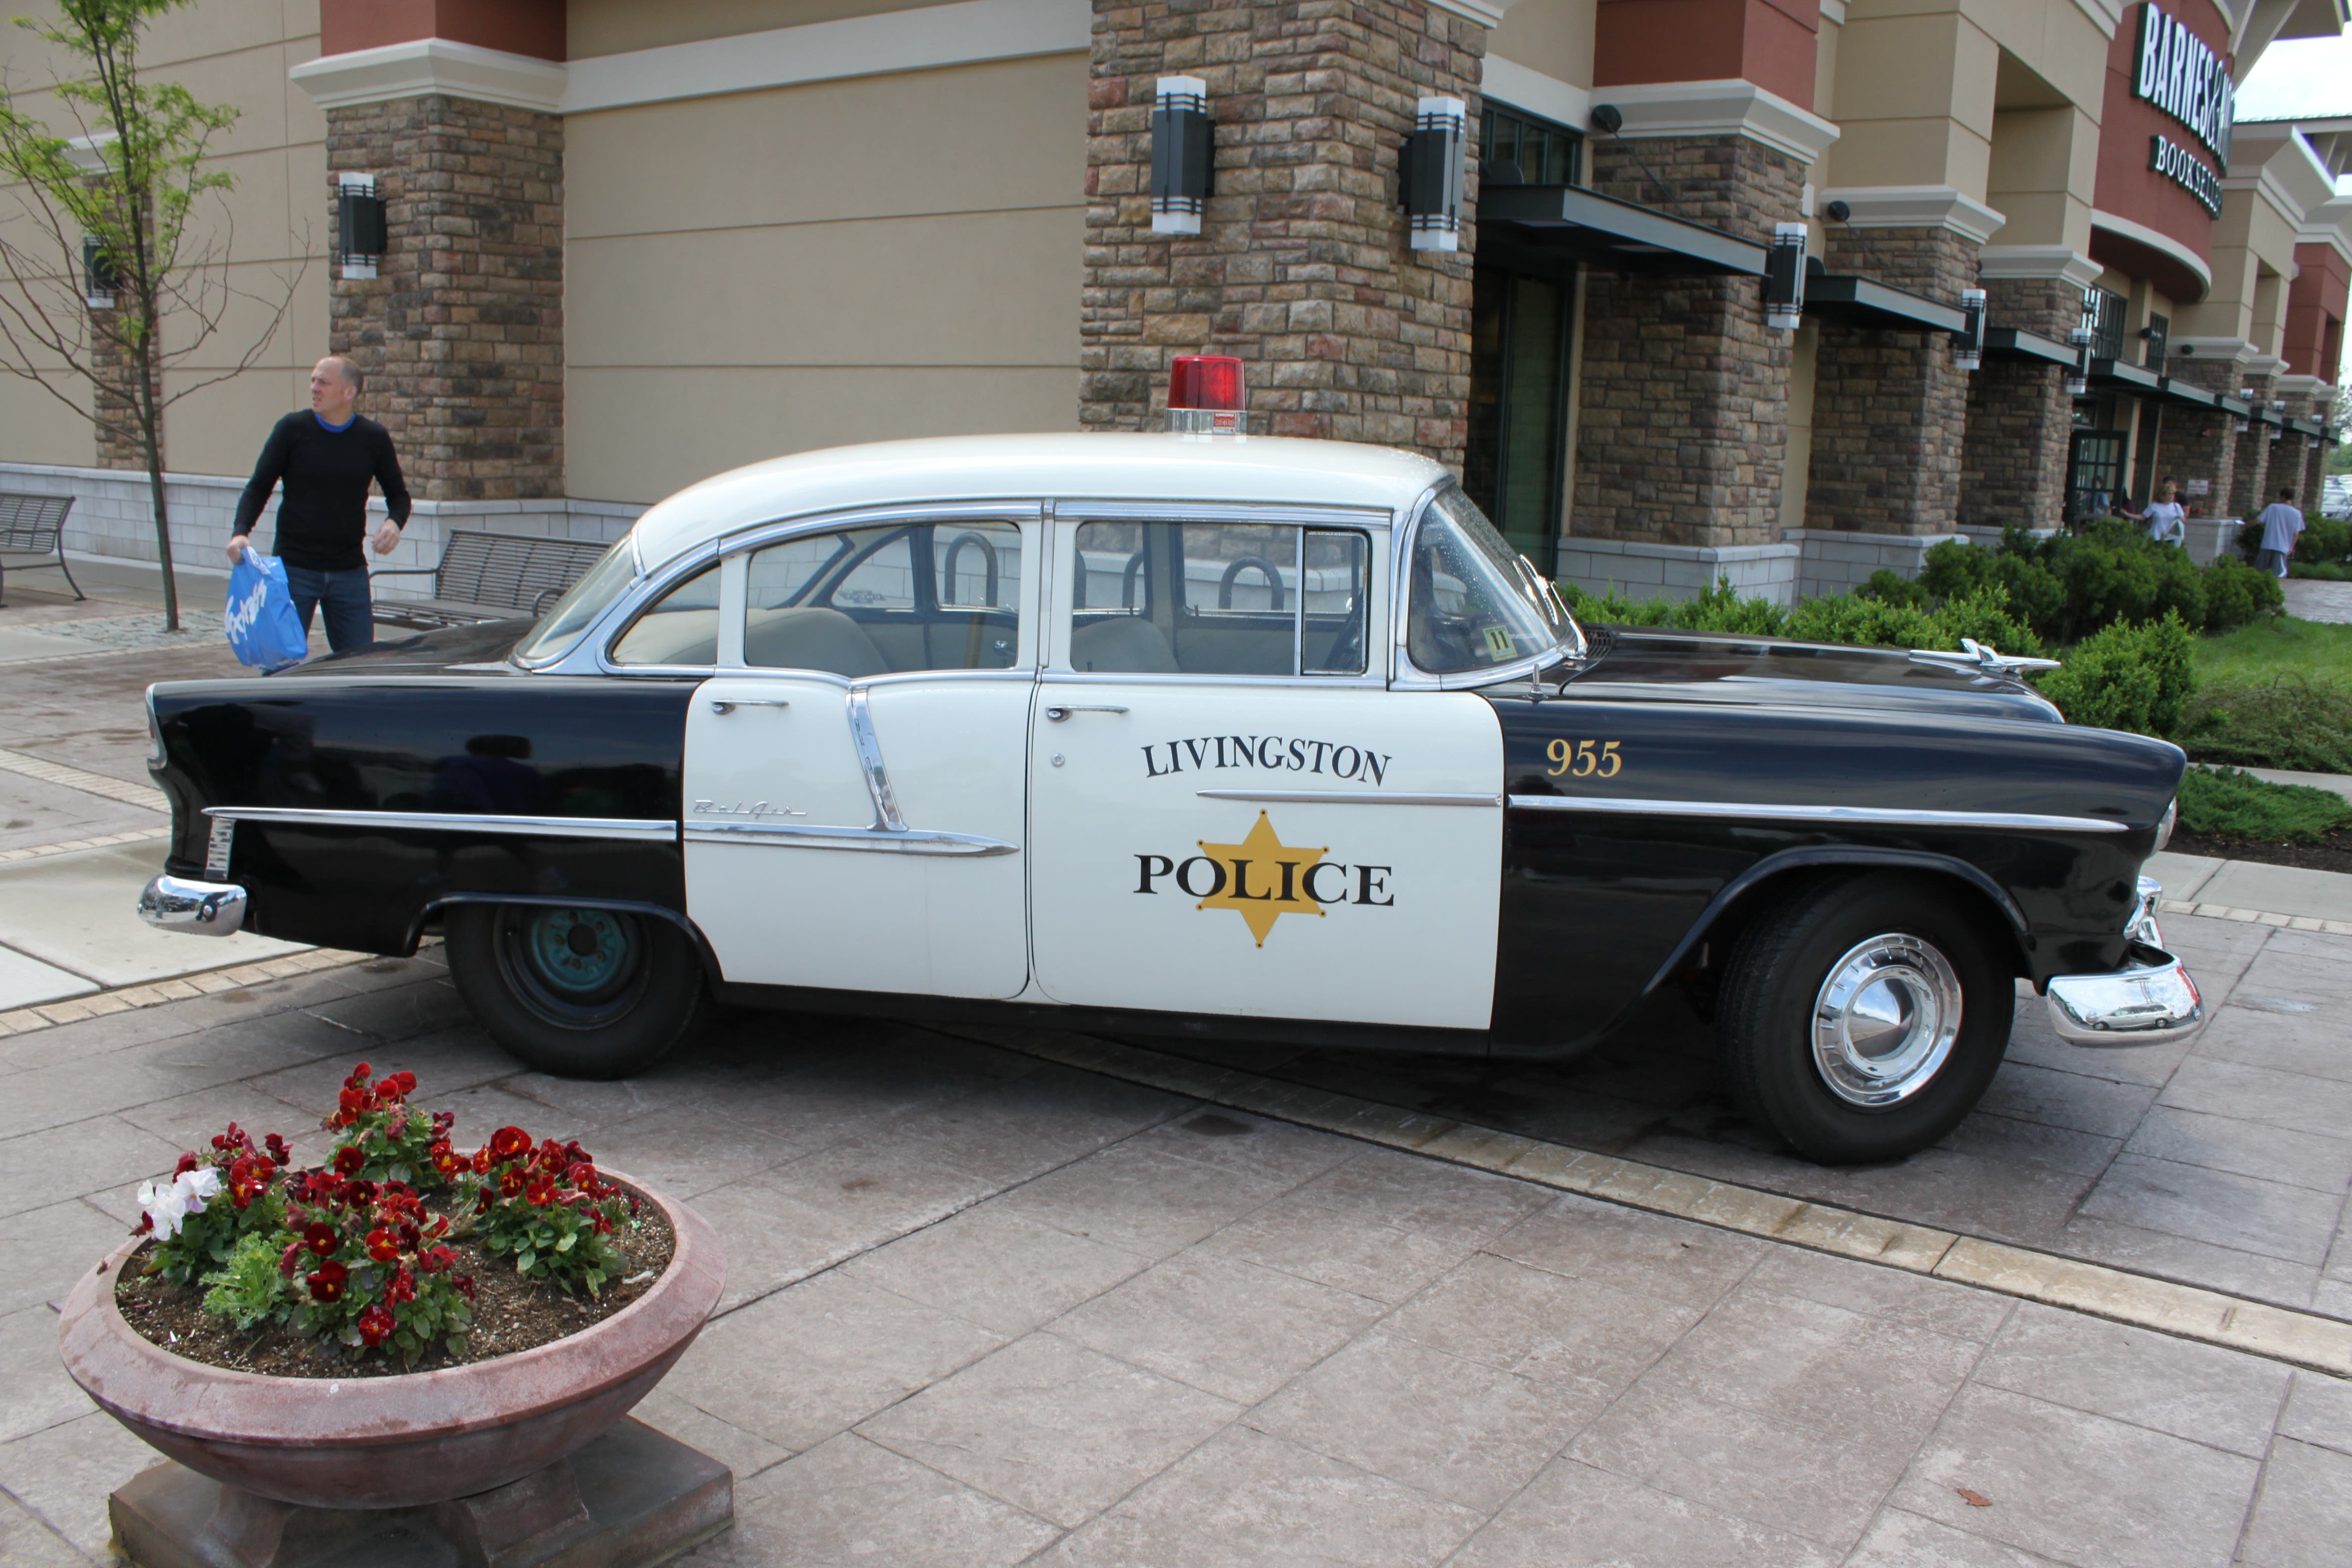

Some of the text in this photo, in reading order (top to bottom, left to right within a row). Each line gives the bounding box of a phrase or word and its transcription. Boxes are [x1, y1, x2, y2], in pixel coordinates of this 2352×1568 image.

[1490, 631, 1509, 650] 11
[1141, 735, 1392, 787] LIVINGSTON
[1547, 738, 1622, 778] 955
[694, 800, 806, 819] Bel Air
[1133, 854, 1394, 906] POLICE
